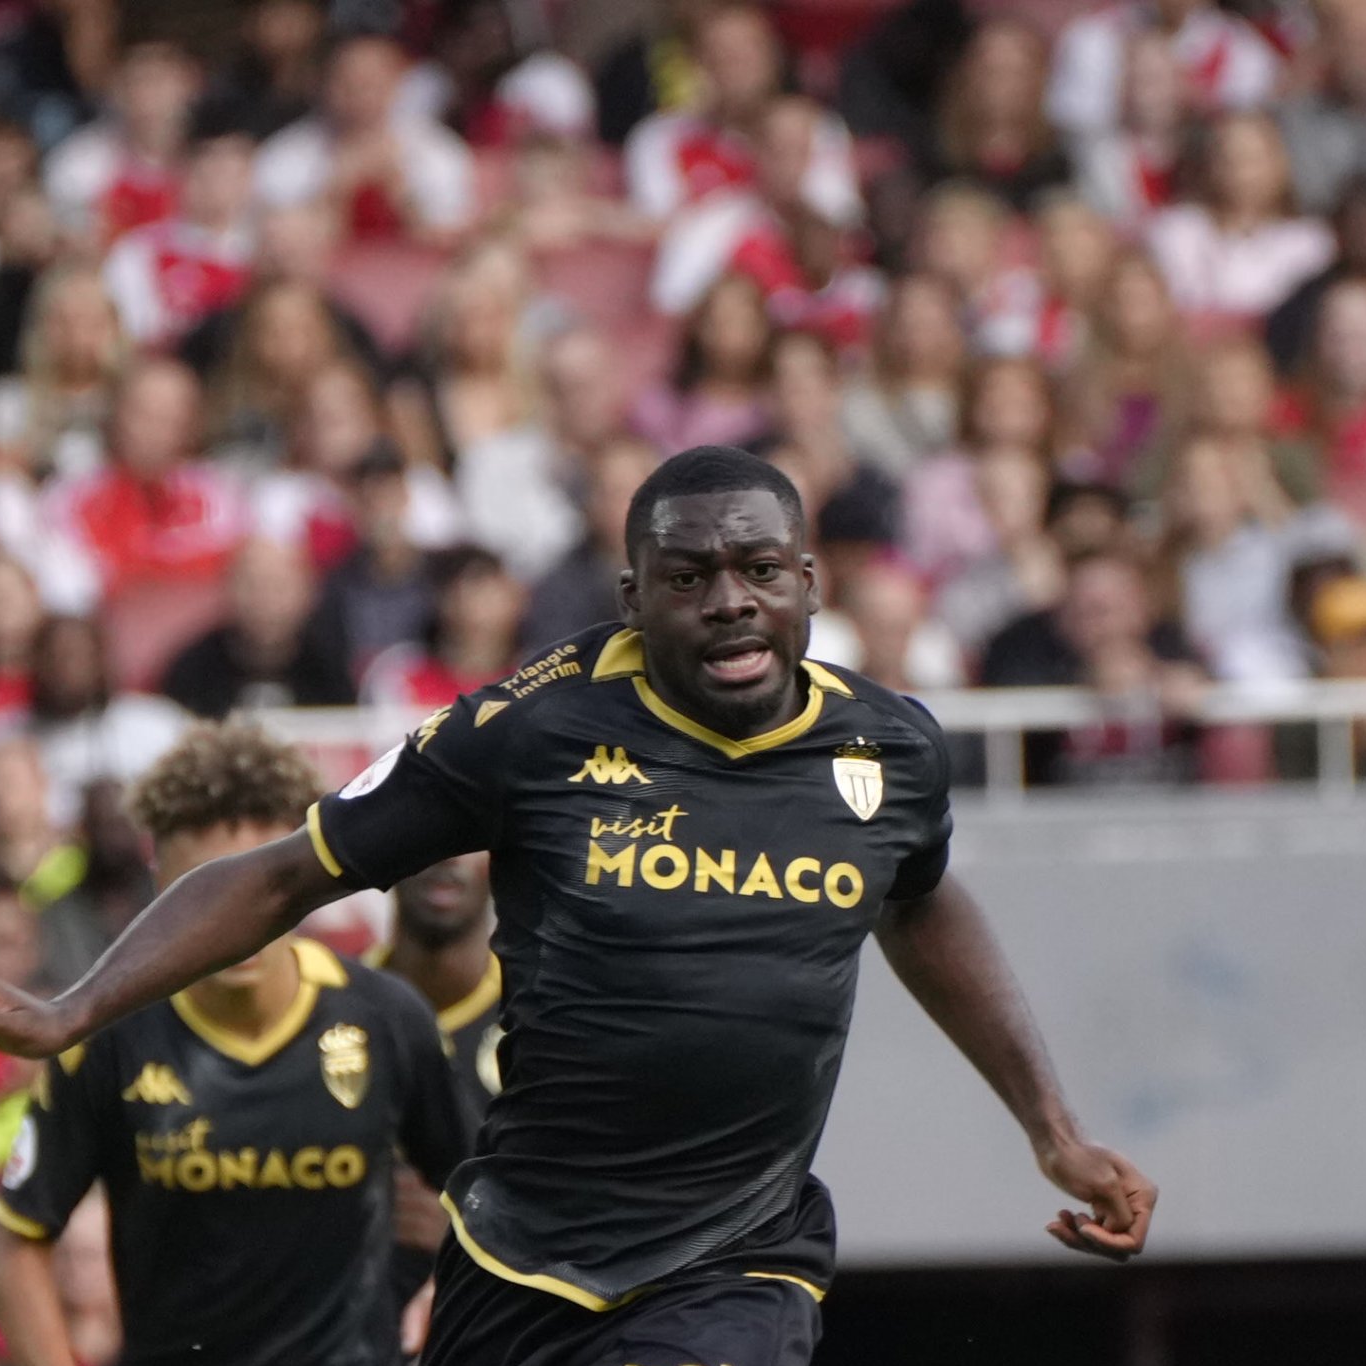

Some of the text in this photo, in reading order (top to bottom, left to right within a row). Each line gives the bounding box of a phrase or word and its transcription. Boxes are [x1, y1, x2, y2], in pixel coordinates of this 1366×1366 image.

[498, 644, 578, 690] Triangle
[590, 804, 689, 841] visit
[585, 839, 864, 909] MONACO
[137, 1144, 366, 1192] MONACO
